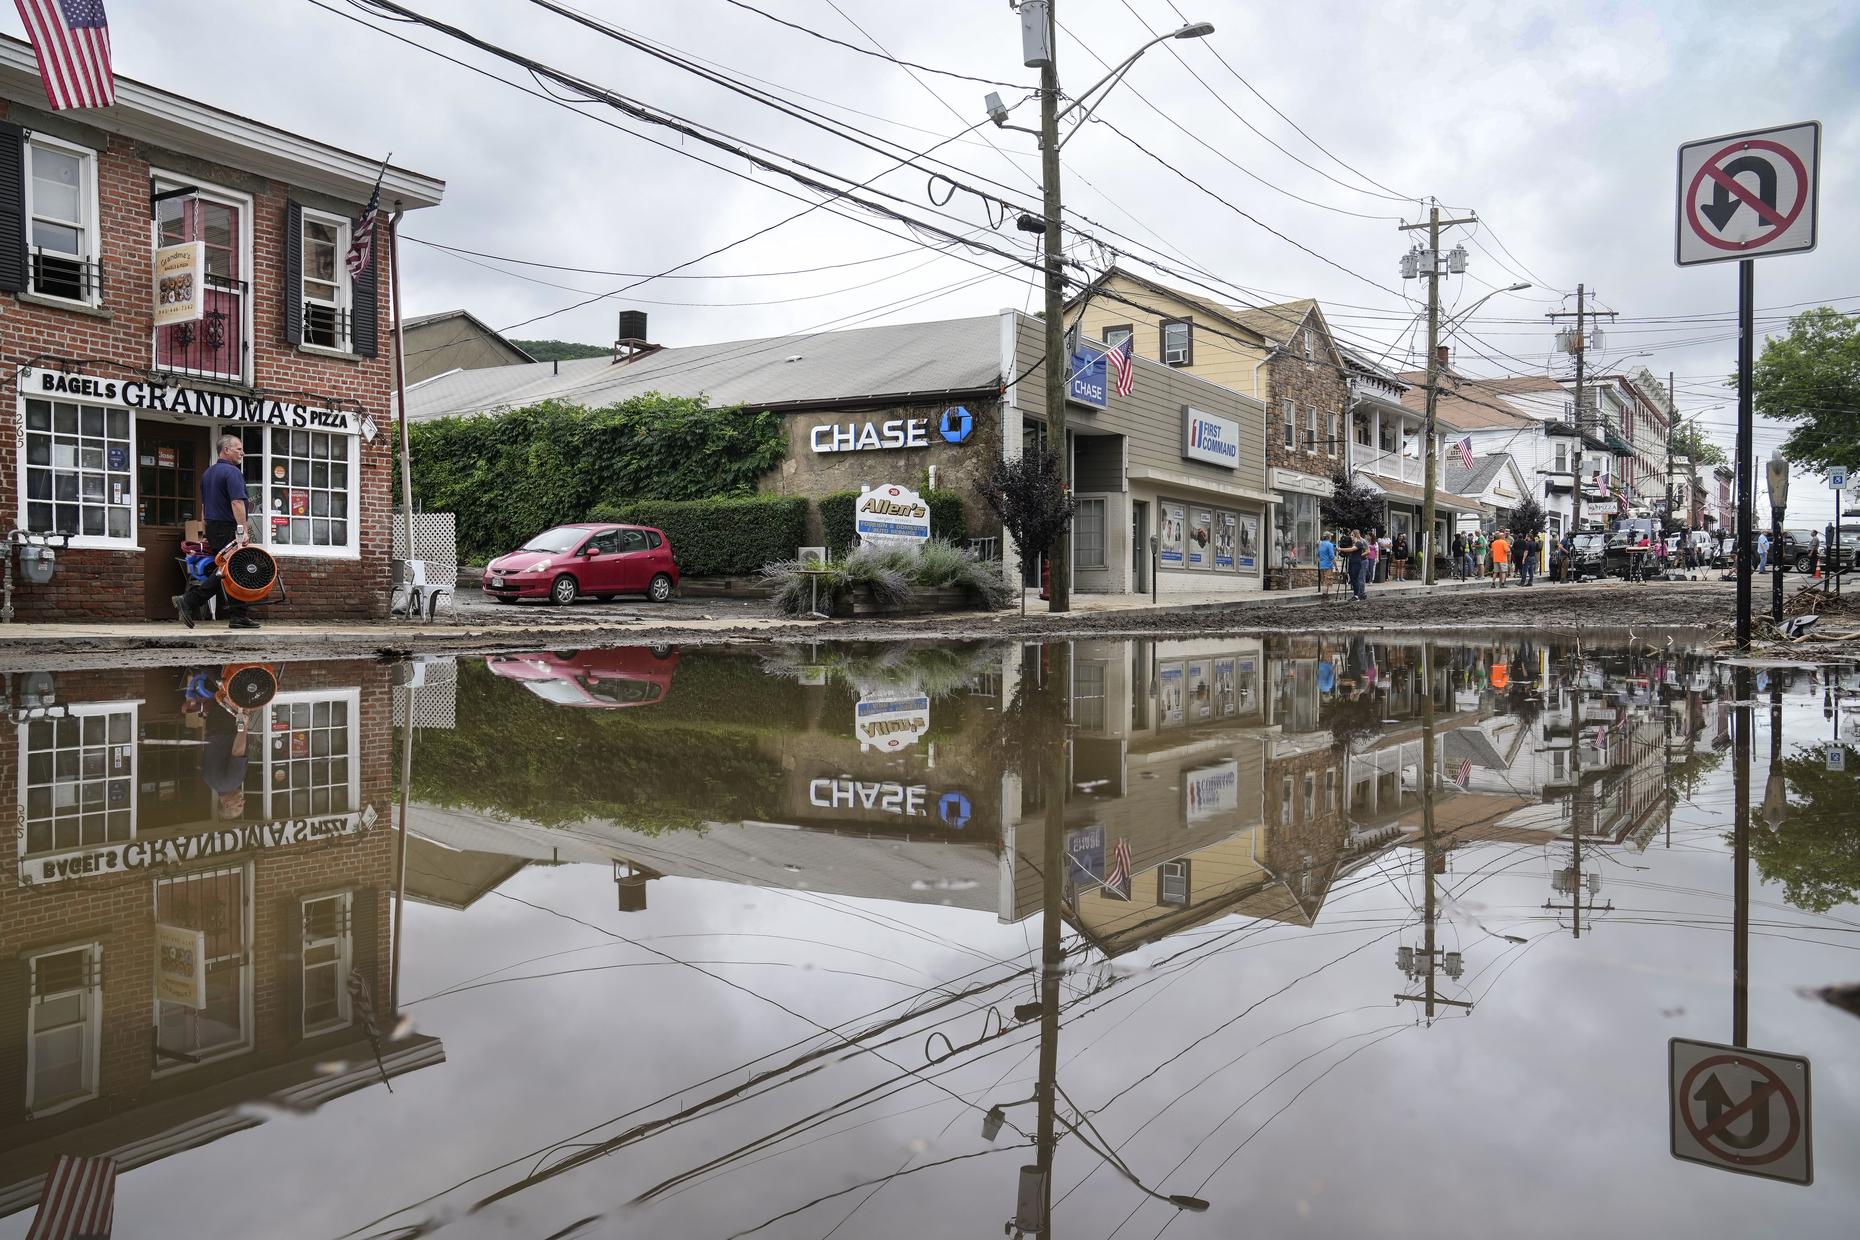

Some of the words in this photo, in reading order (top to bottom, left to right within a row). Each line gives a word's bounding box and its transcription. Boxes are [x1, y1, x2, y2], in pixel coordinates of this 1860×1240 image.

[1074, 380, 1102, 401] CHASE
[42, 374, 116, 399] BAGELS
[121, 382, 307, 428] GRANDMA'S
[310, 410, 348, 429] PIZZA
[16, 413, 24, 449] 265
[810, 418, 929, 453] CHASE
[1203, 422, 1221, 438] FIRST
[1202, 437, 1236, 457] COMMAND
[860, 498, 926, 518] Allen's
